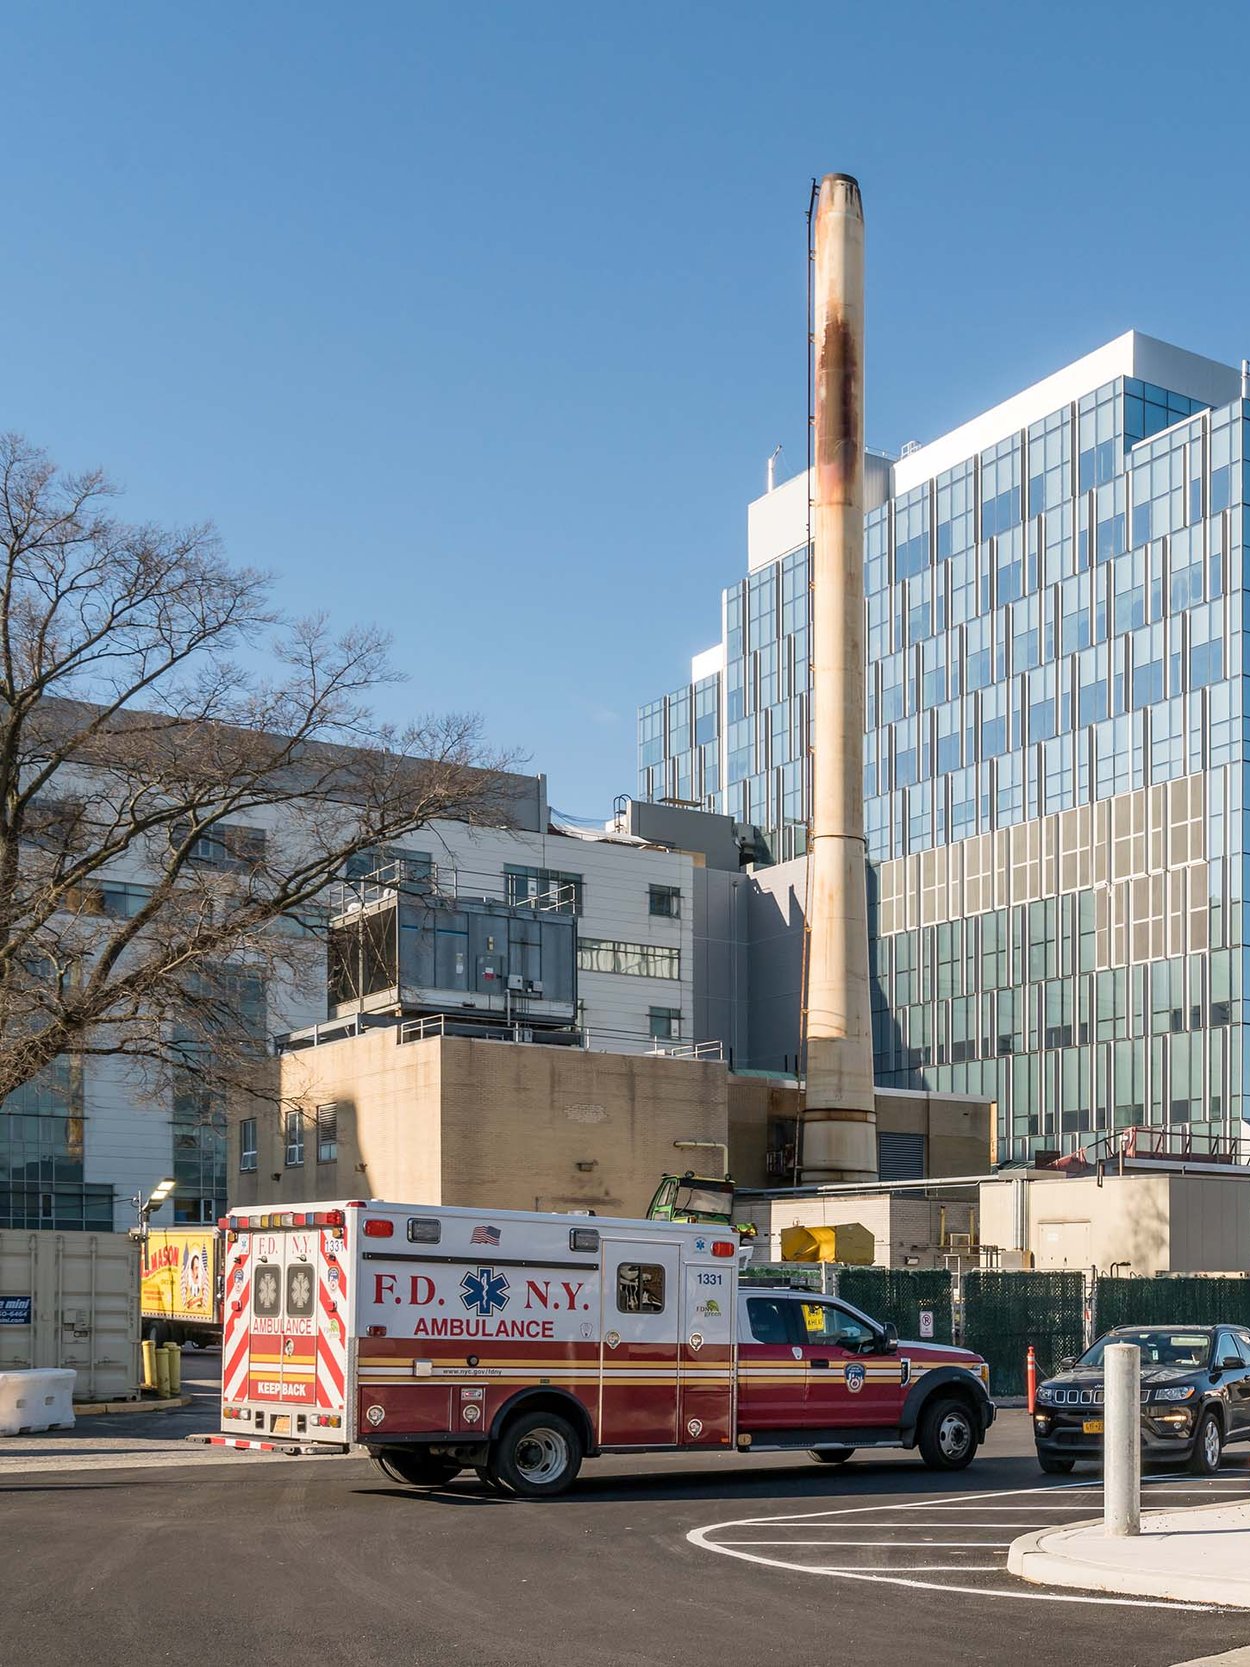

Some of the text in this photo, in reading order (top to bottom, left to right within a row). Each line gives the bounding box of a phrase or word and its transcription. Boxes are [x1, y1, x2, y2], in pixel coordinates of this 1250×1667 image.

[259, 1235, 312, 1254] F.D. N.Y.
[325, 1240, 344, 1252] 1331
[697, 1273, 722, 1285] 1331
[373, 1273, 589, 1311] F.D. N.Y.
[5, 1298, 30, 1309] mini
[253, 1318, 312, 1335] AMBULANCE
[413, 1317, 555, 1338] AMBULANCE
[257, 1381, 306, 1396] KEEP BACK
